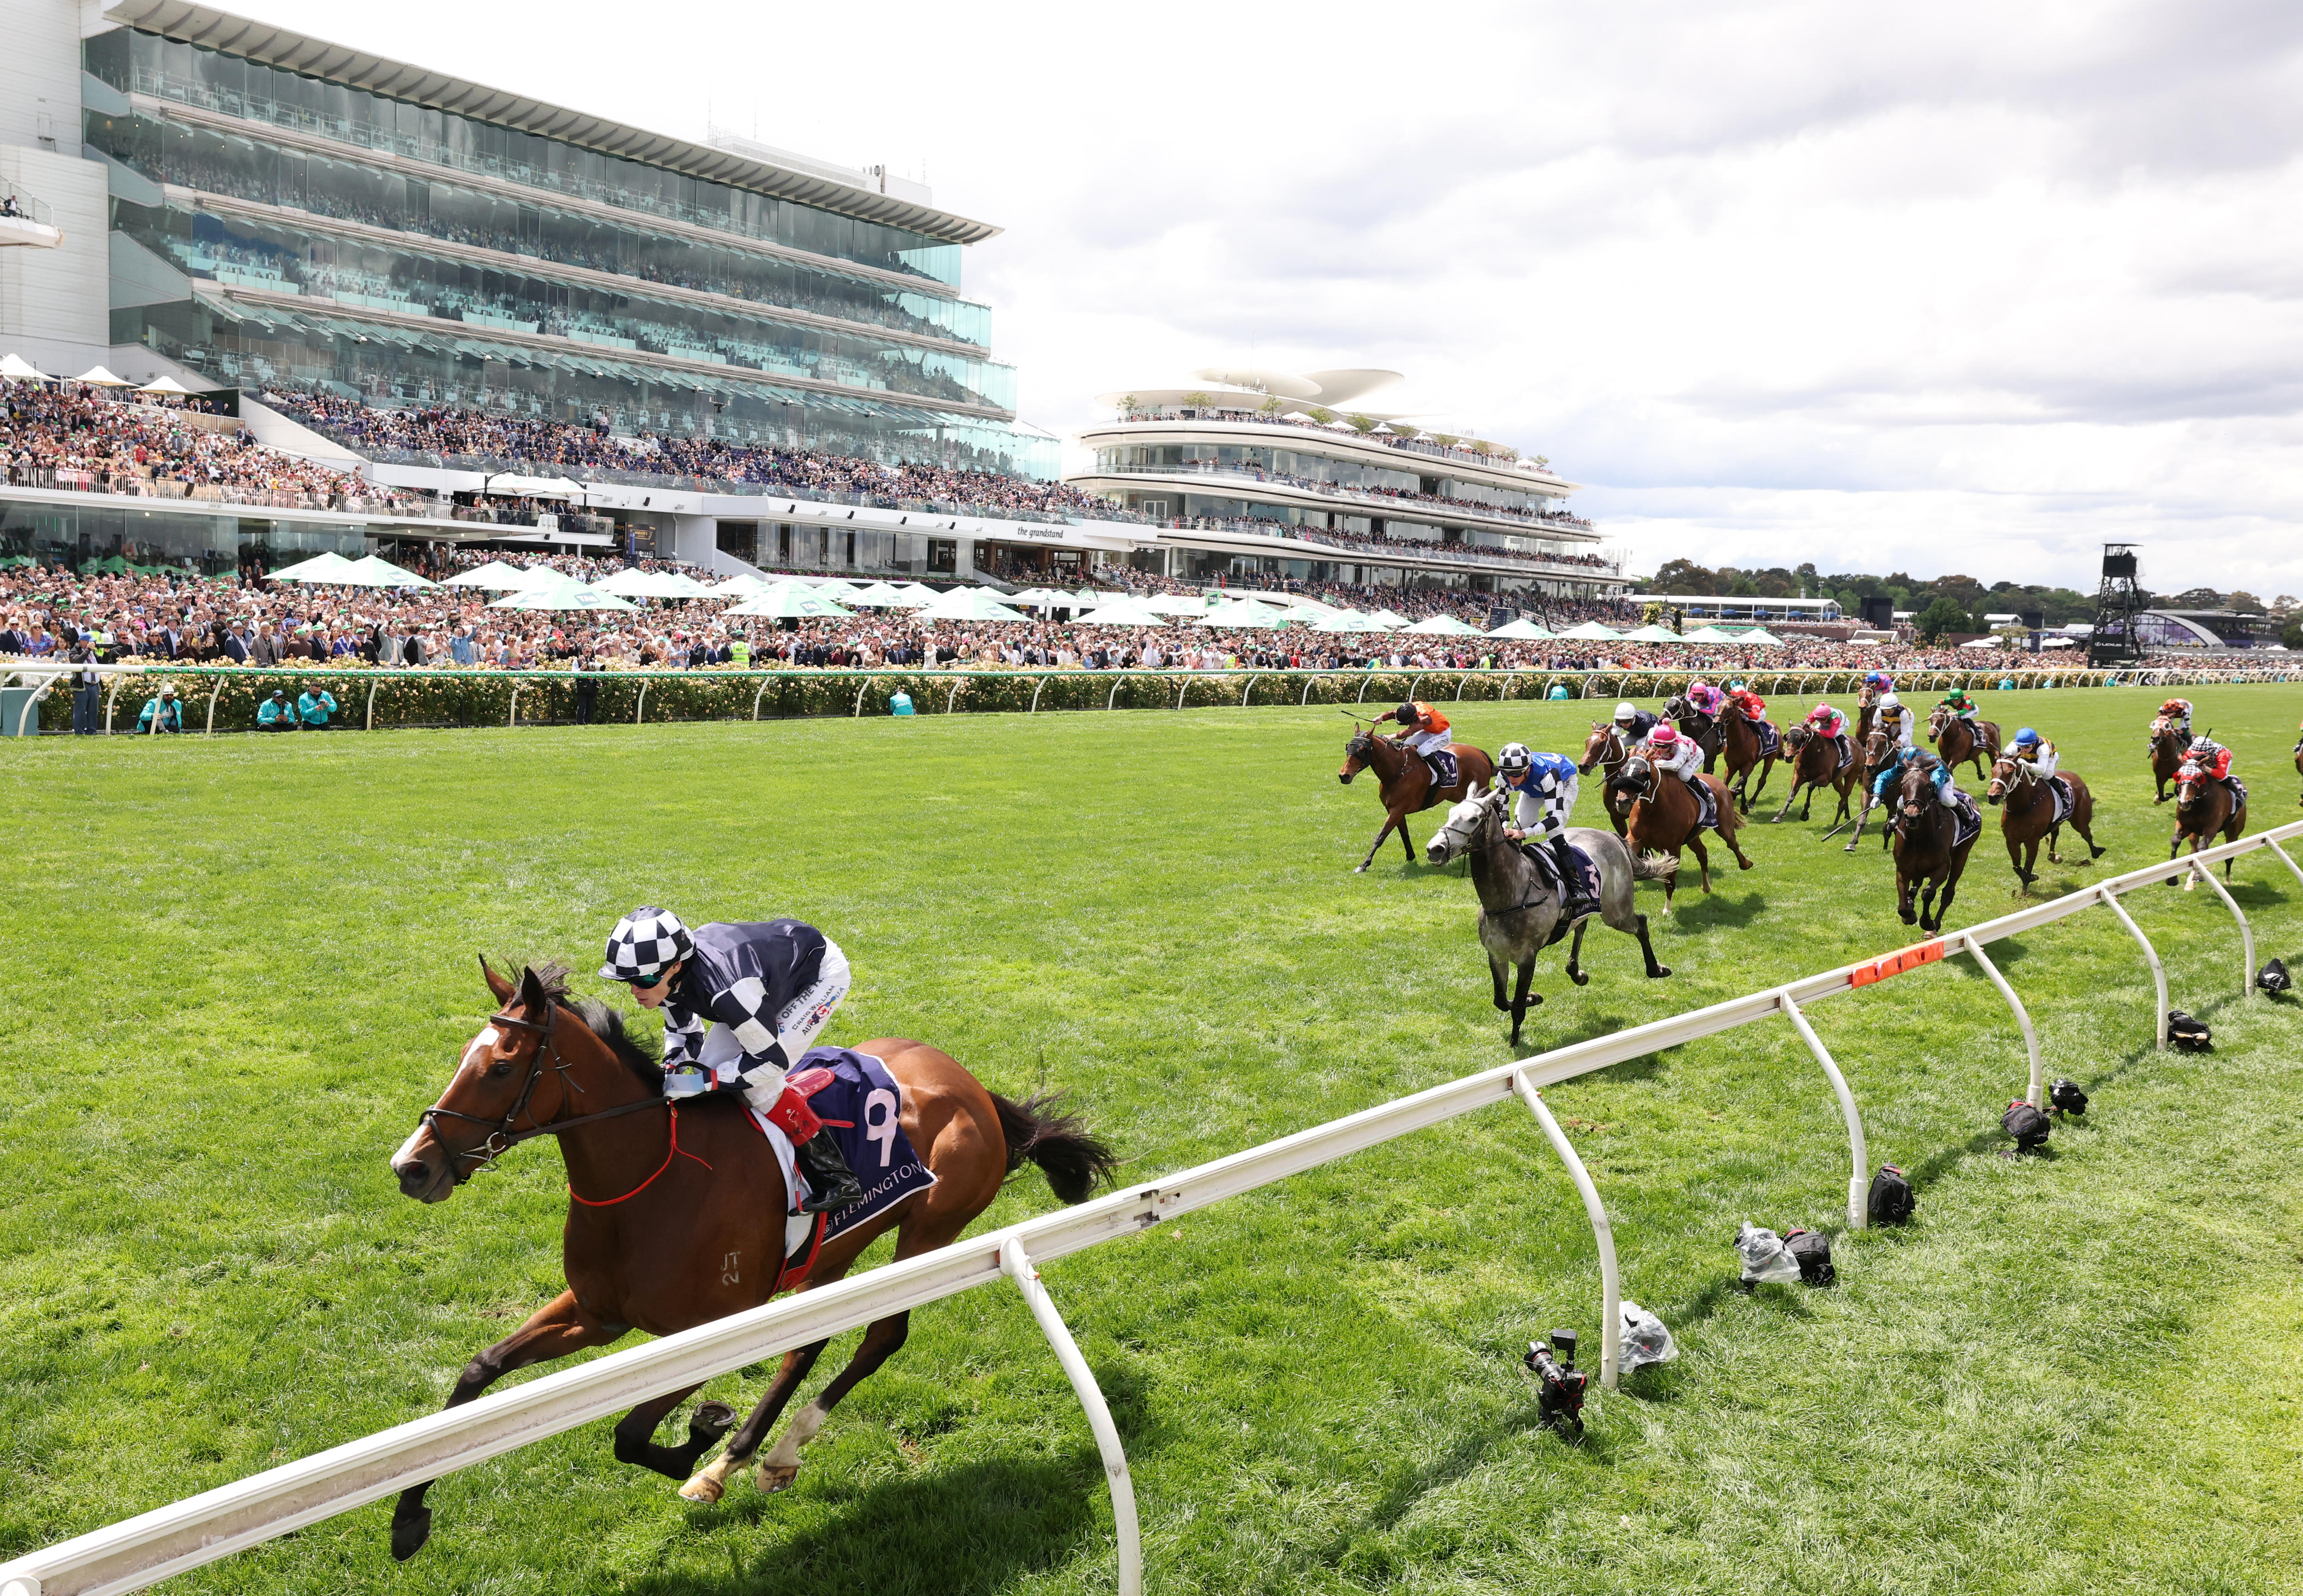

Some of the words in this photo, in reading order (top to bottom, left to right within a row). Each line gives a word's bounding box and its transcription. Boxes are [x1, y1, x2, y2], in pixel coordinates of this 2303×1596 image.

[1017, 526, 1028, 535] the
[1029, 529, 1064, 538] grandstand
[1584, 864, 1600, 899] 3
[782, 1002, 797, 1019] OFF
[796, 986, 815, 1005] THE
[802, 1025, 812, 1036] AU
[835, 987, 844, 998] UA
[792, 1011, 811, 1030] CRAIG
[865, 1088, 898, 1167] 9
[834, 1160, 923, 1227] FLEMINGTON
